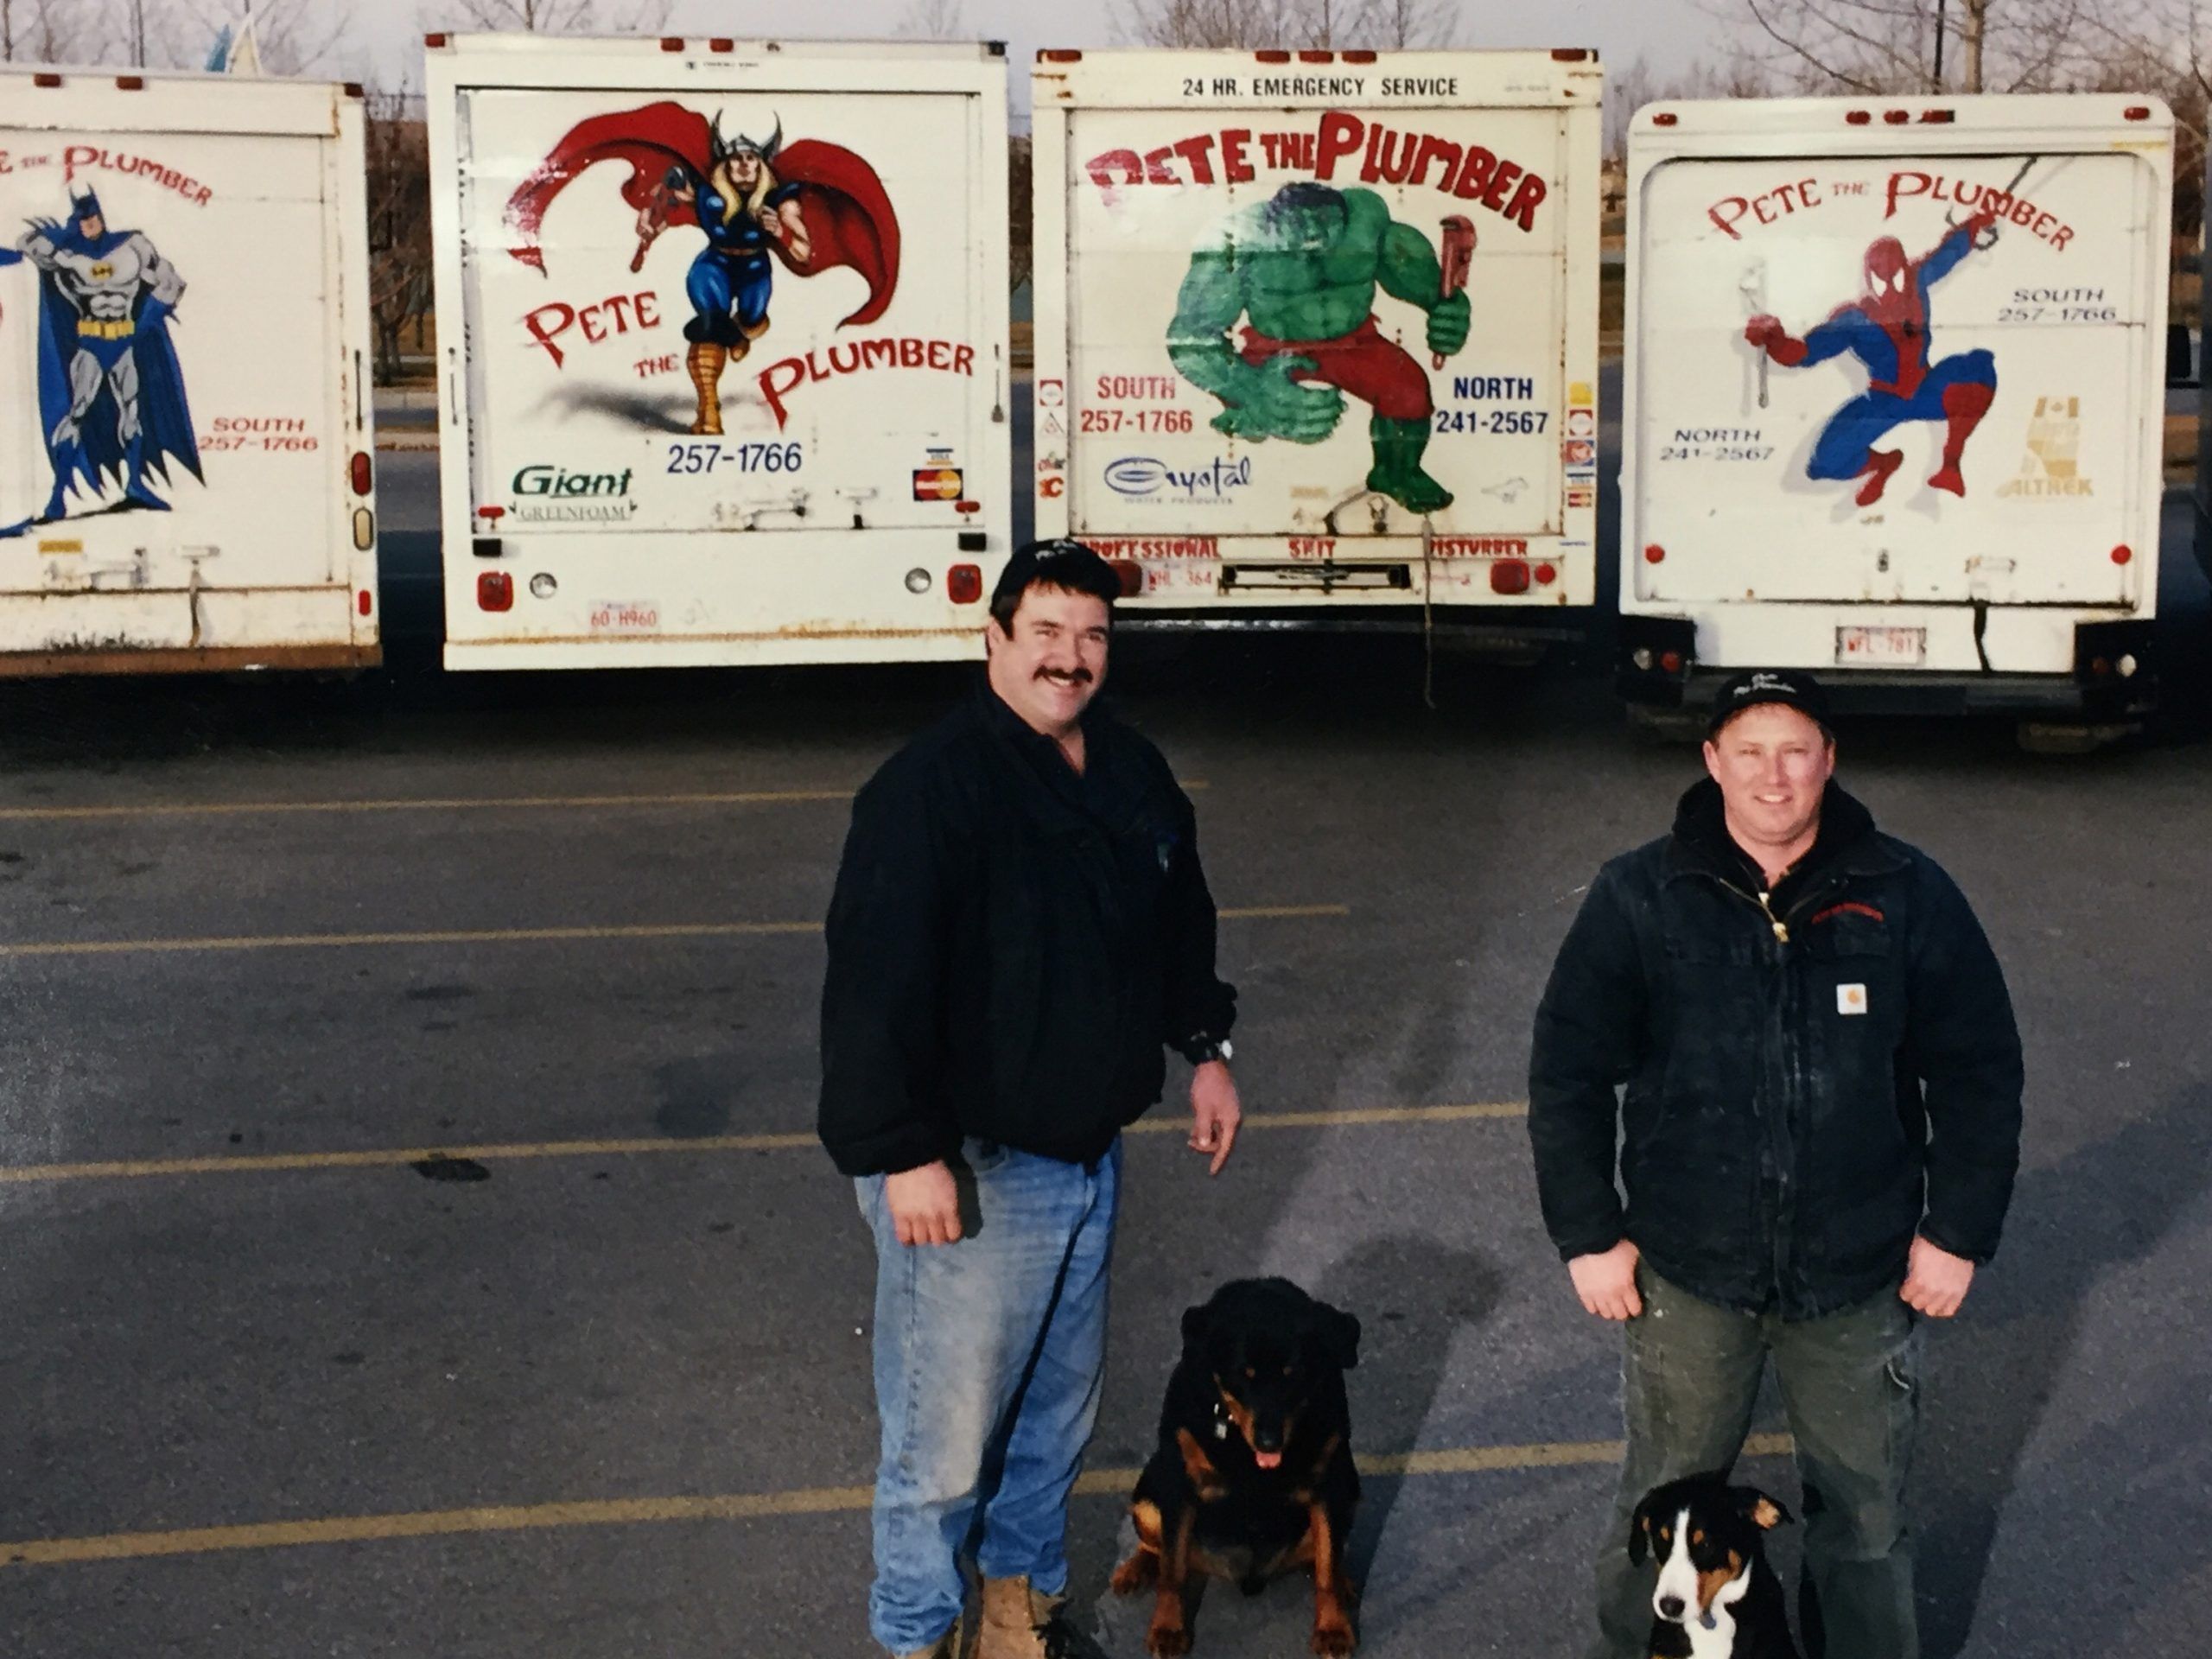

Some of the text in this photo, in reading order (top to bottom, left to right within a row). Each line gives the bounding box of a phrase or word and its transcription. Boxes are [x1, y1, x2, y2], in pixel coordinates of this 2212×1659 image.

[1183, 78, 1458, 96] 24 HR. EMERGENCY SERVICE
[63, 145, 213, 206] PLUMBER
[1084, 111, 1547, 232] PETE THE PLUMBER
[1707, 178, 1822, 240] PETE
[1885, 172, 2075, 251] PLUMBER
[2013, 288, 2104, 302] SOUTH
[1998, 307, 2116, 321] 257-1766
[524, 290, 975, 433] PETE THE PLUMBER
[1096, 375, 1176, 399] SOUTH
[1453, 376, 1533, 400] NORTH
[213, 416, 305, 432] SOUTH
[1080, 409, 1193, 433] 257-1766
[1436, 410, 1549, 434] 241-2567
[198, 435, 318, 450] 257-1766
[1675, 429, 1761, 442] NORTH
[667, 442, 802, 474] 257-1766
[1660, 446, 1775, 461] 241-2567
[512, 465, 633, 498] Giant
[1103, 456, 1251, 497] Crystal
[1078, 537, 1222, 559] ROFESSIONAL
